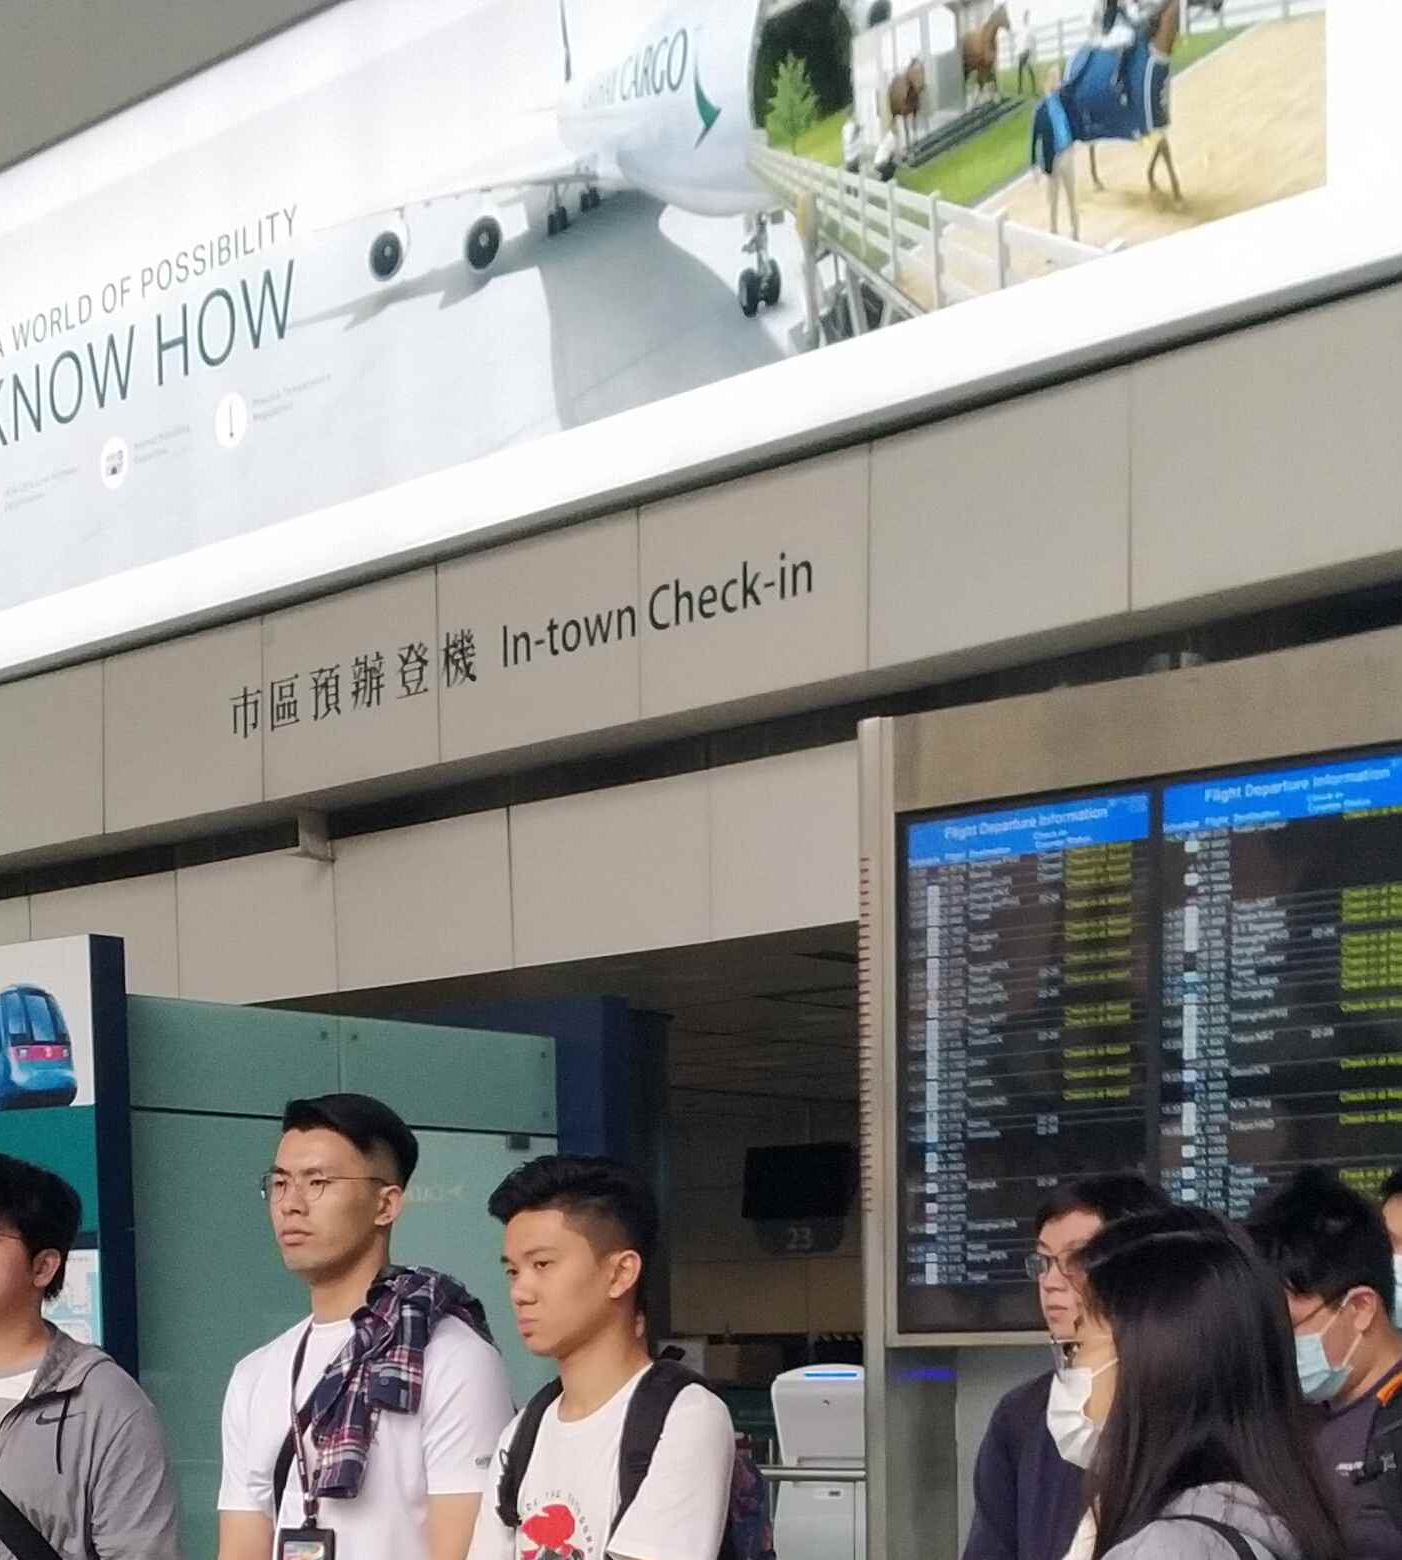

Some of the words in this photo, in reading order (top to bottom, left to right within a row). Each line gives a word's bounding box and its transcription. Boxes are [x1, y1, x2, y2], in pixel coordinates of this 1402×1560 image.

[11, 294, 93, 352] WORLD
[101, 276, 134, 314] OF
[140, 204, 299, 299] POSSIBILITY
[156, 258, 296, 388] HOW
[501, 603, 638, 669] In-town
[648, 552, 814, 631] Check-in
